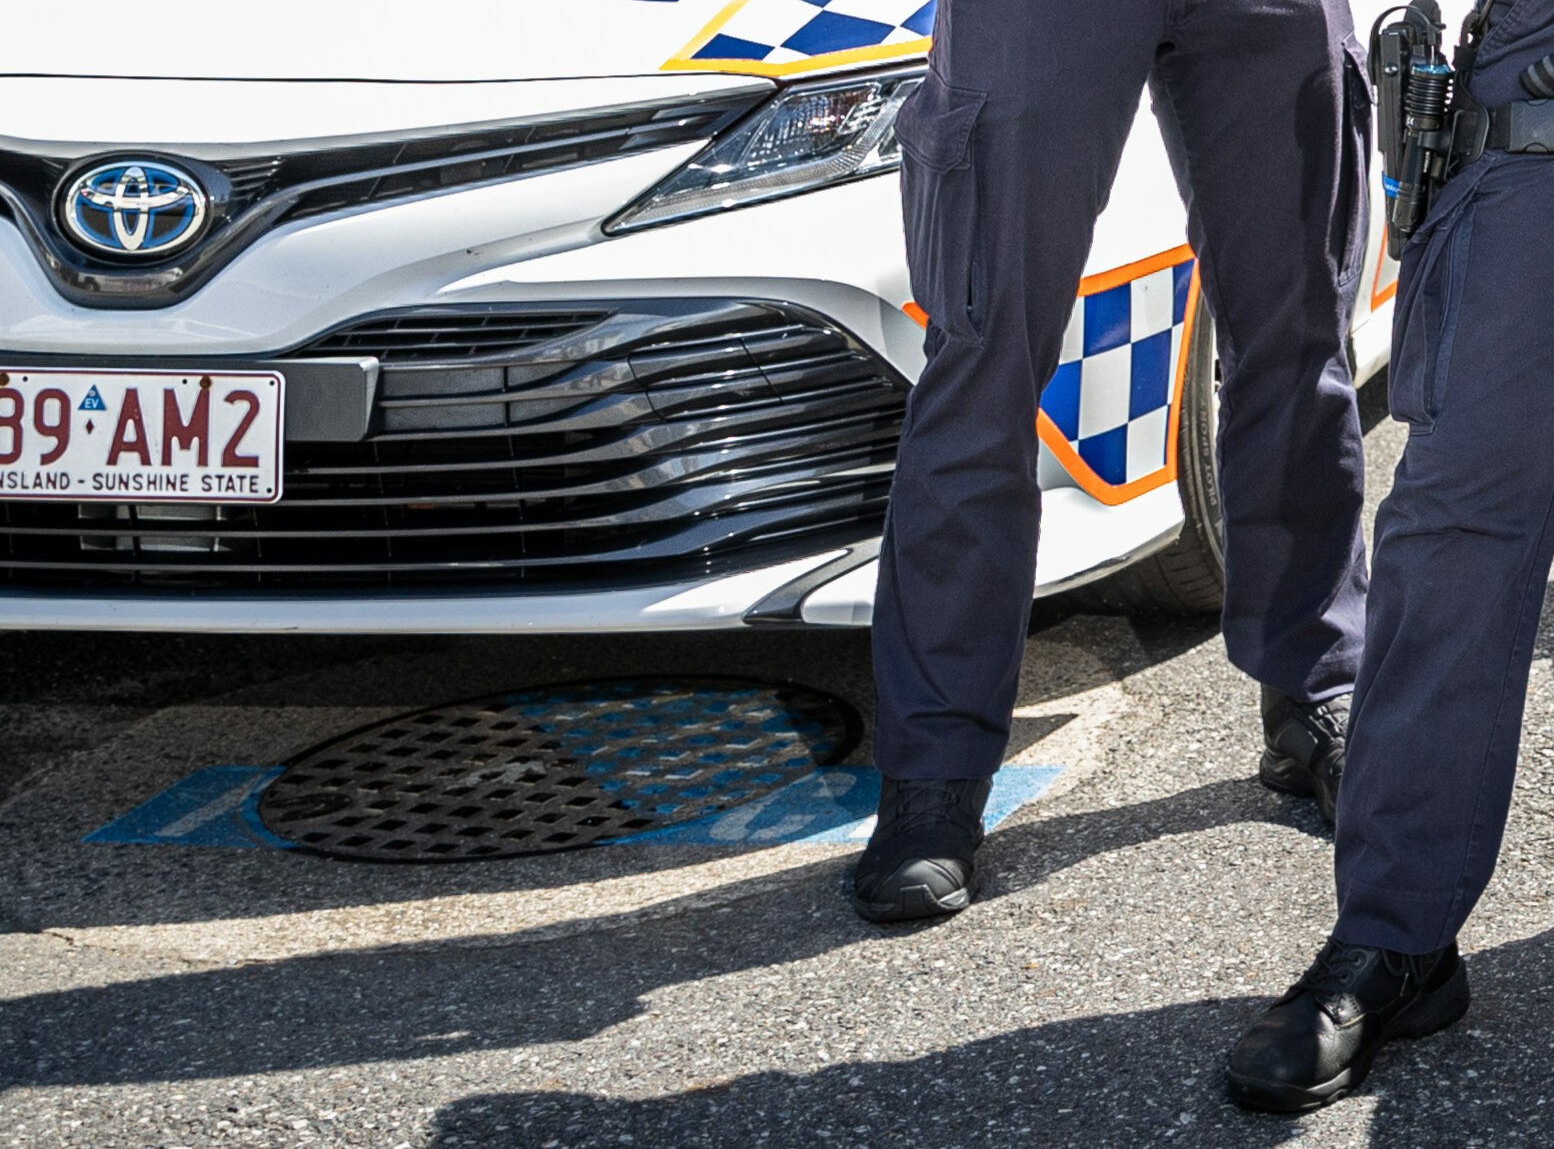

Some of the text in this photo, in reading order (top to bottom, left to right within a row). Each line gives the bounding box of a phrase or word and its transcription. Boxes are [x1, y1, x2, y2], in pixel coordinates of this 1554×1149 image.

[84, 397, 99, 409] EV
[92, 472, 190, 492] SUNSHINE
[201, 474, 260, 494] STATE
